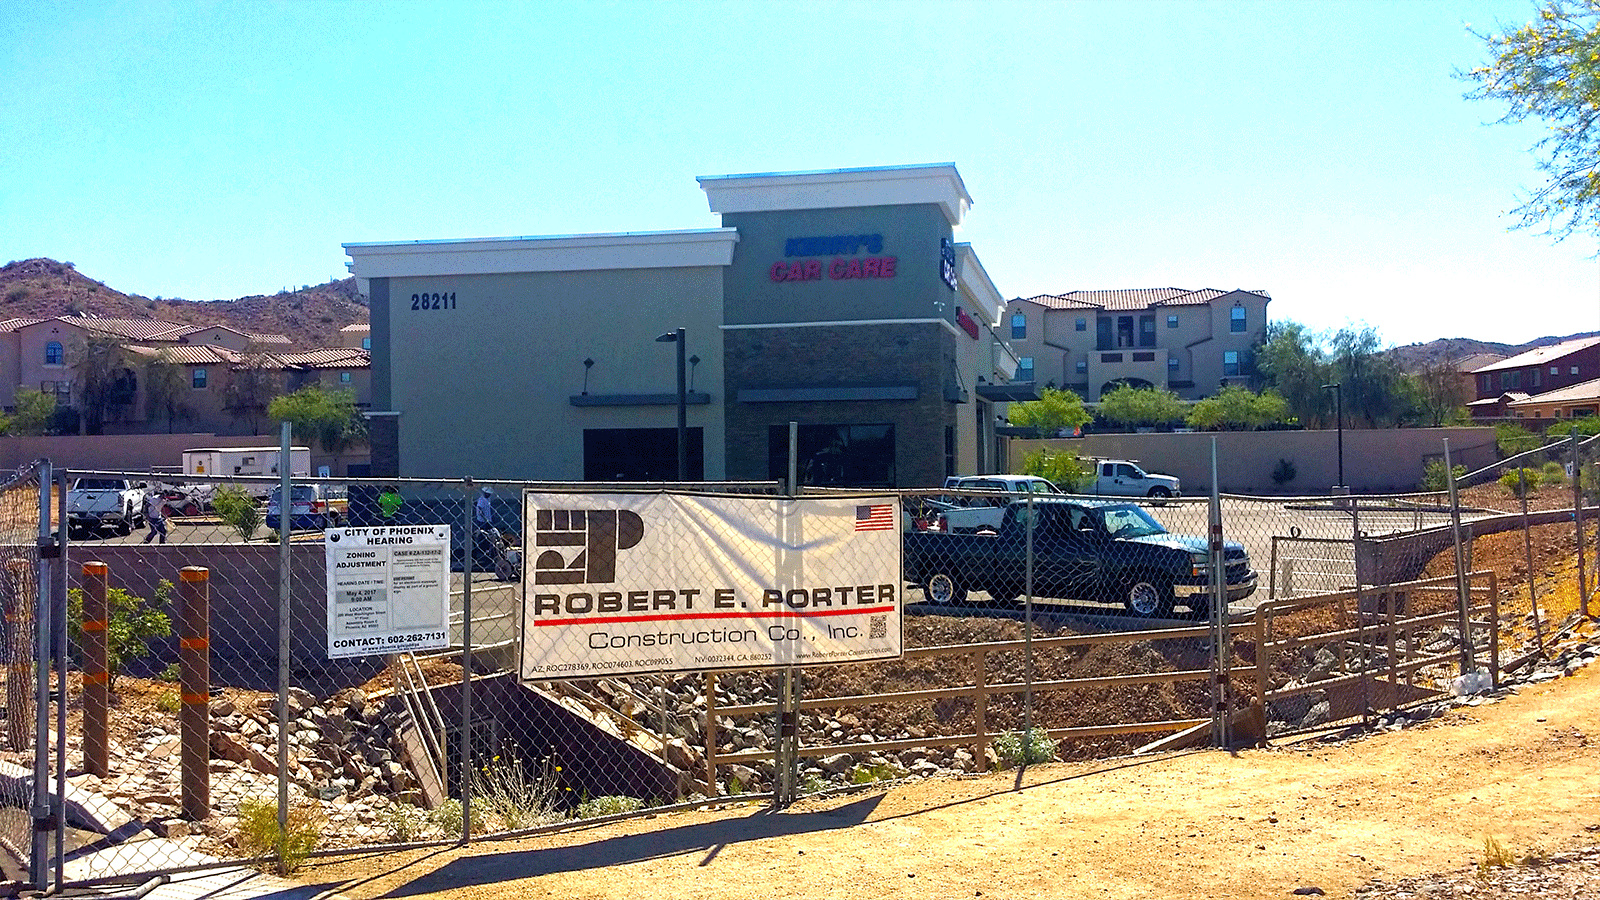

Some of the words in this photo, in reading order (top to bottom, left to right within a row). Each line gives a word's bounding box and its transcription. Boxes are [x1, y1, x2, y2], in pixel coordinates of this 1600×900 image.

[769, 260, 822, 282] CAR
[828, 256, 898, 280] CARE
[411, 292, 456, 310] 28211
[344, 528, 369, 537] CITY
[372, 528, 386, 536] OF
[389, 527, 435, 535] PHOENIX
[366, 537, 413, 545] HEARING
[336, 560, 387, 568] ADJUSTMENT
[534, 589, 701, 615] ROBERT
[714, 588, 747, 608] E.
[762, 583, 895, 608] PORTER
[333, 637, 385, 648] CONTACT:
[387, 631, 446, 644] 602-262-7131
[588, 627, 757, 649] Construction
[768, 625, 816, 642] Co.,
[827, 624, 863, 639] Inc.
[546, 663, 591, 673] ROC278369,
